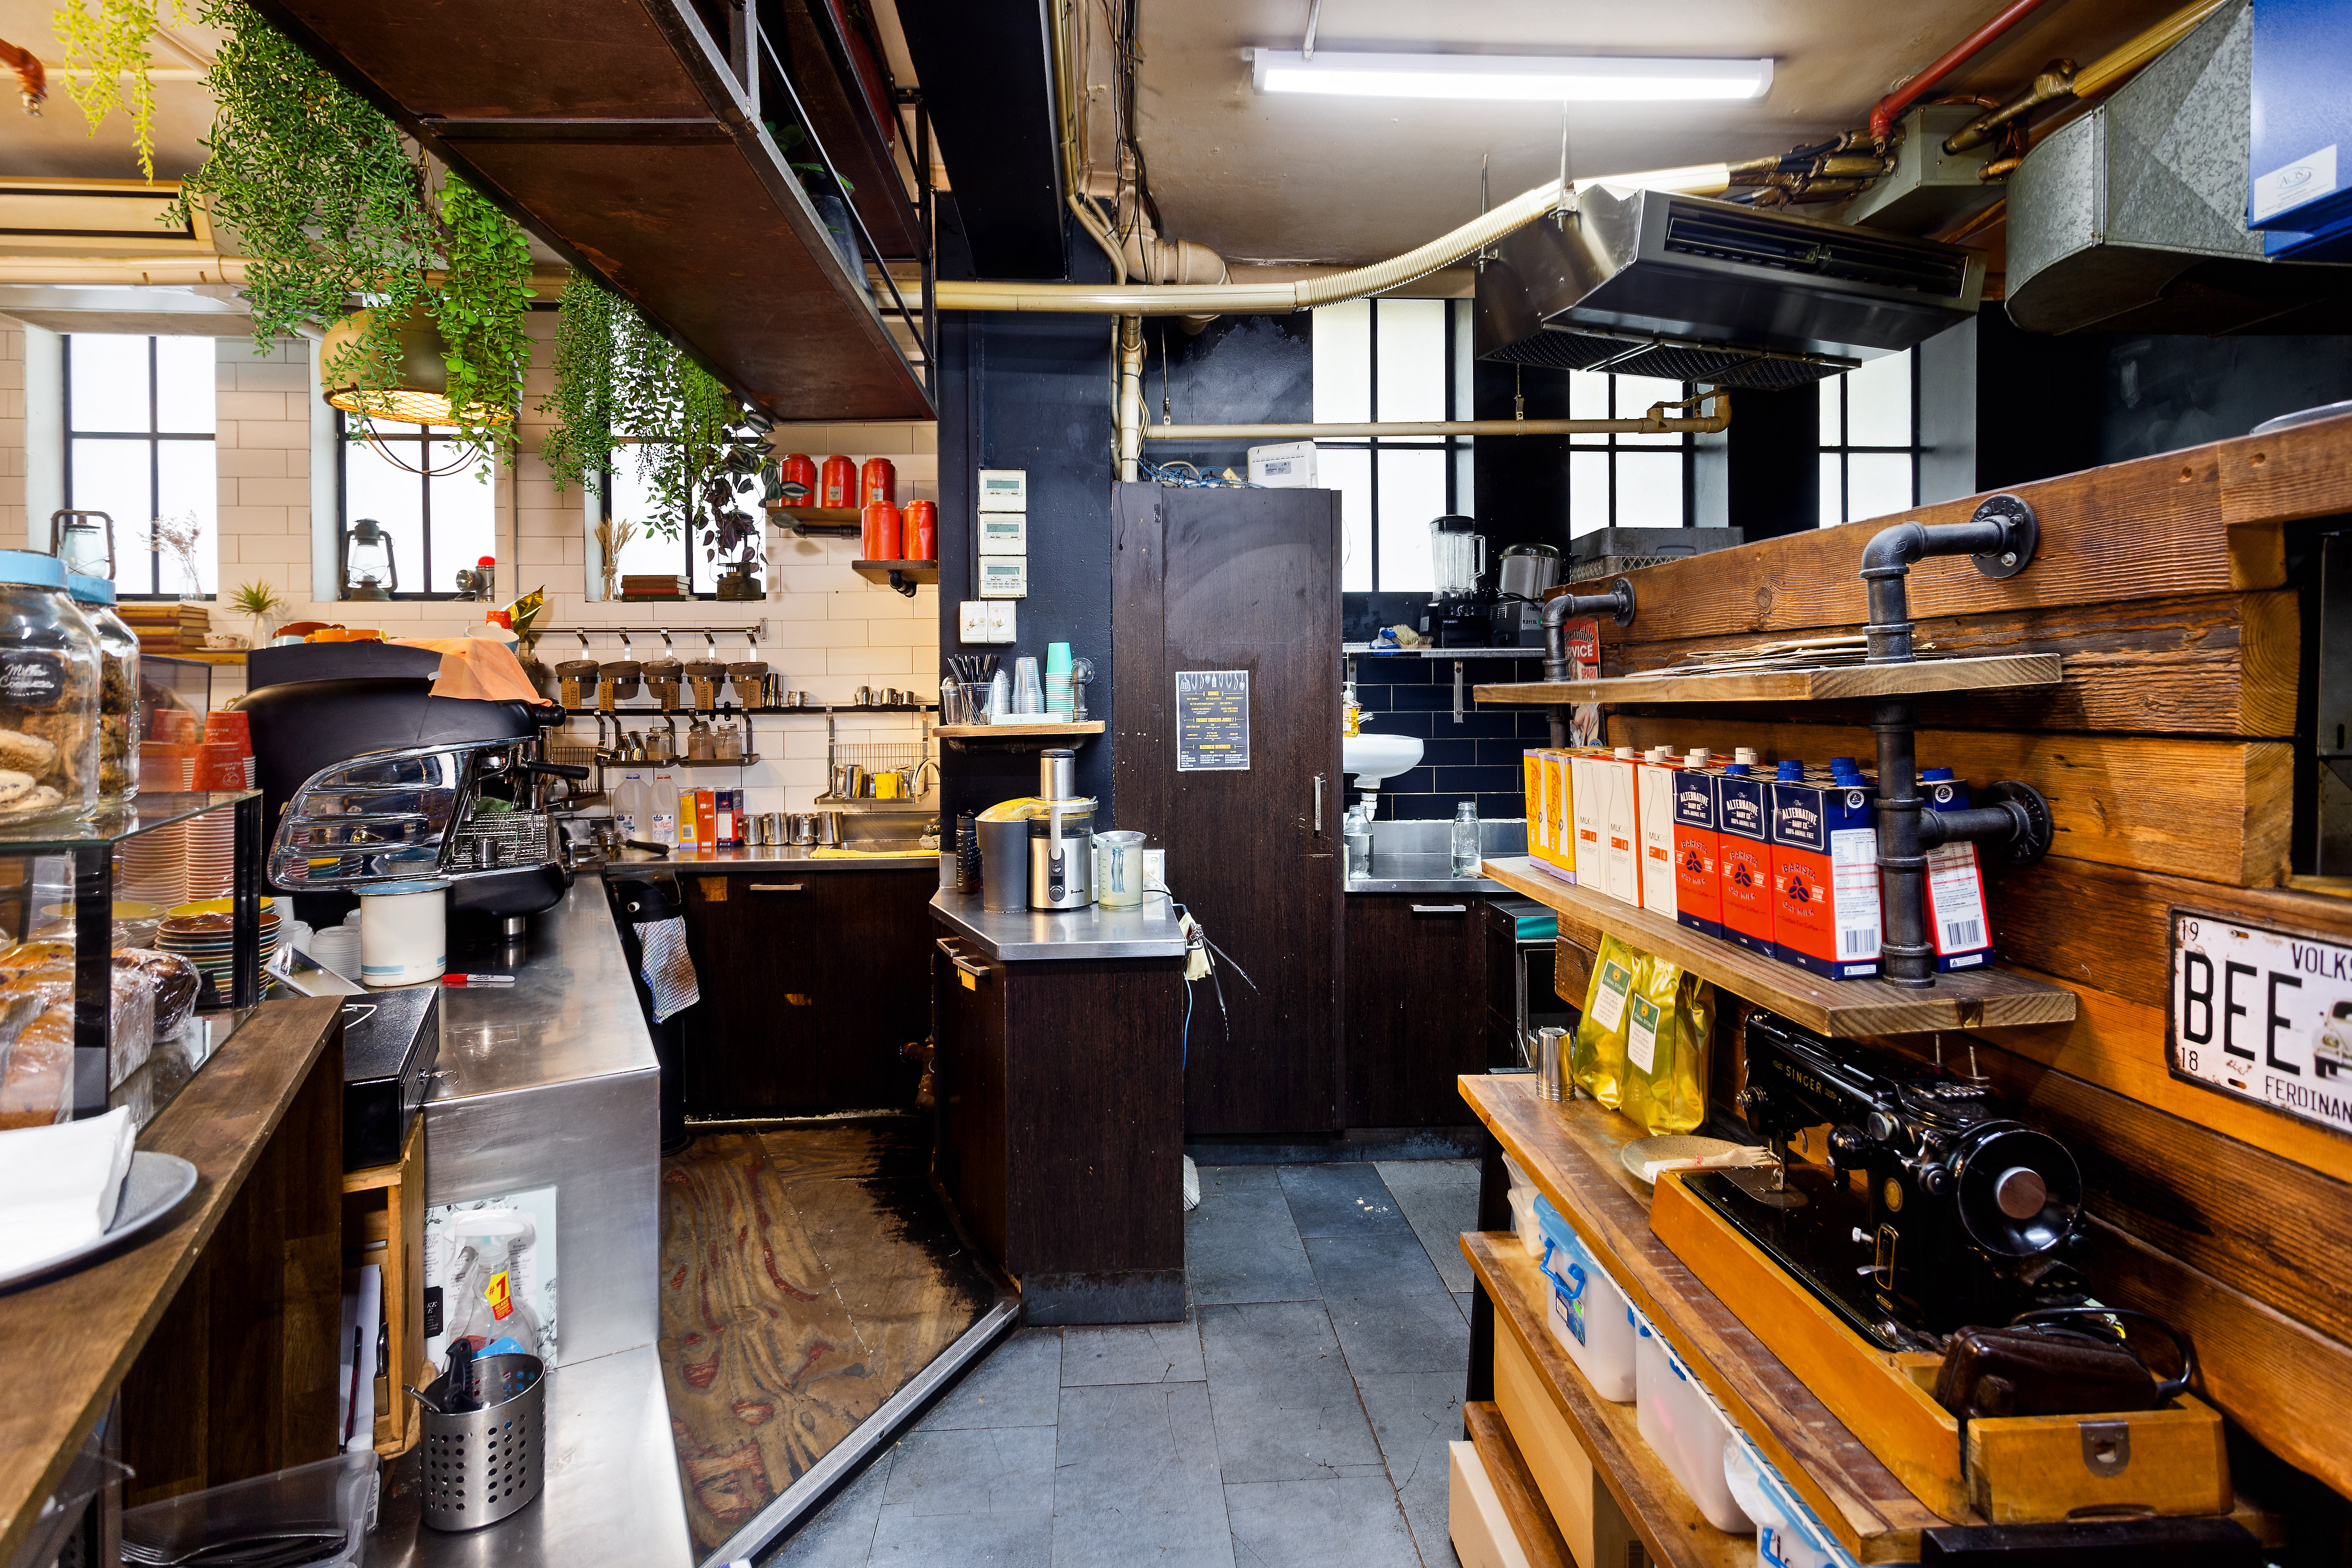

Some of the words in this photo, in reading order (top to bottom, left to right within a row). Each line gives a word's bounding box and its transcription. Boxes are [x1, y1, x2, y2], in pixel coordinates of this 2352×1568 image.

[1564, 621, 1594, 645] ependable
[1526, 762, 1541, 821] Bonsoy
[1547, 766, 1562, 829] Bonsoy
[1680, 791, 1709, 807] ALTERNATIVE
[1726, 799, 1759, 816] ALTERNATIVE
[1782, 807, 1818, 825] ALTERNATIVE
[1681, 839, 1707, 854] BARISTA
[1730, 851, 1758, 867] BARISTA
[1681, 872, 1691, 883] OAT
[1782, 864, 1816, 881] BARISTA
[1729, 885, 1740, 897] OAT
[1746, 905, 1759, 913] Coffee
[1783, 901, 1796, 913] OAT
[1798, 908, 1815, 916] MILK
[1782, 916, 1796, 925] Crafted
[1804, 922, 1819, 931] Coffee
[2182, 919, 2199, 941] 19
[2292, 943, 2352, 982] VOLK
[2184, 950, 2302, 1075] BEE
[2181, 1047, 2198, 1071] 18
[1786, 1066, 1821, 1094] SINGER
[489, 1275, 505, 1300] #1
[495, 1298, 508, 1310] GLASS
